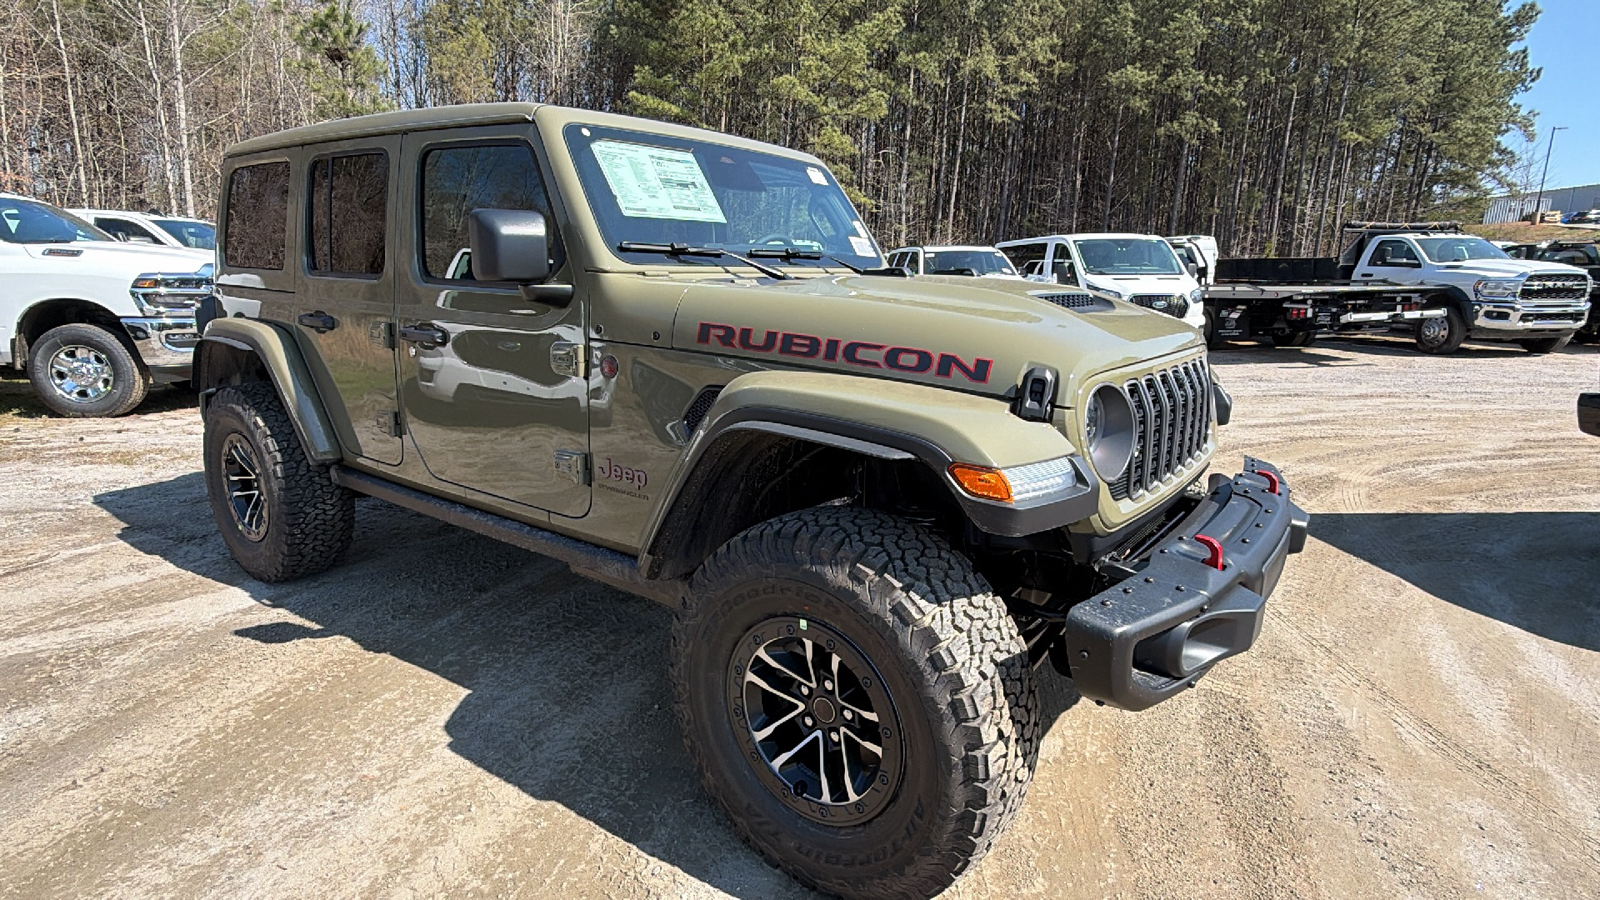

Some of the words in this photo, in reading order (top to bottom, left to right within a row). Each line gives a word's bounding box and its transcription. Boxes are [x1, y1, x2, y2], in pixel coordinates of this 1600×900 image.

[696, 321, 993, 385] RUBICON
[598, 457, 648, 491] Jeep
[604, 485, 649, 501] WRANGLER
